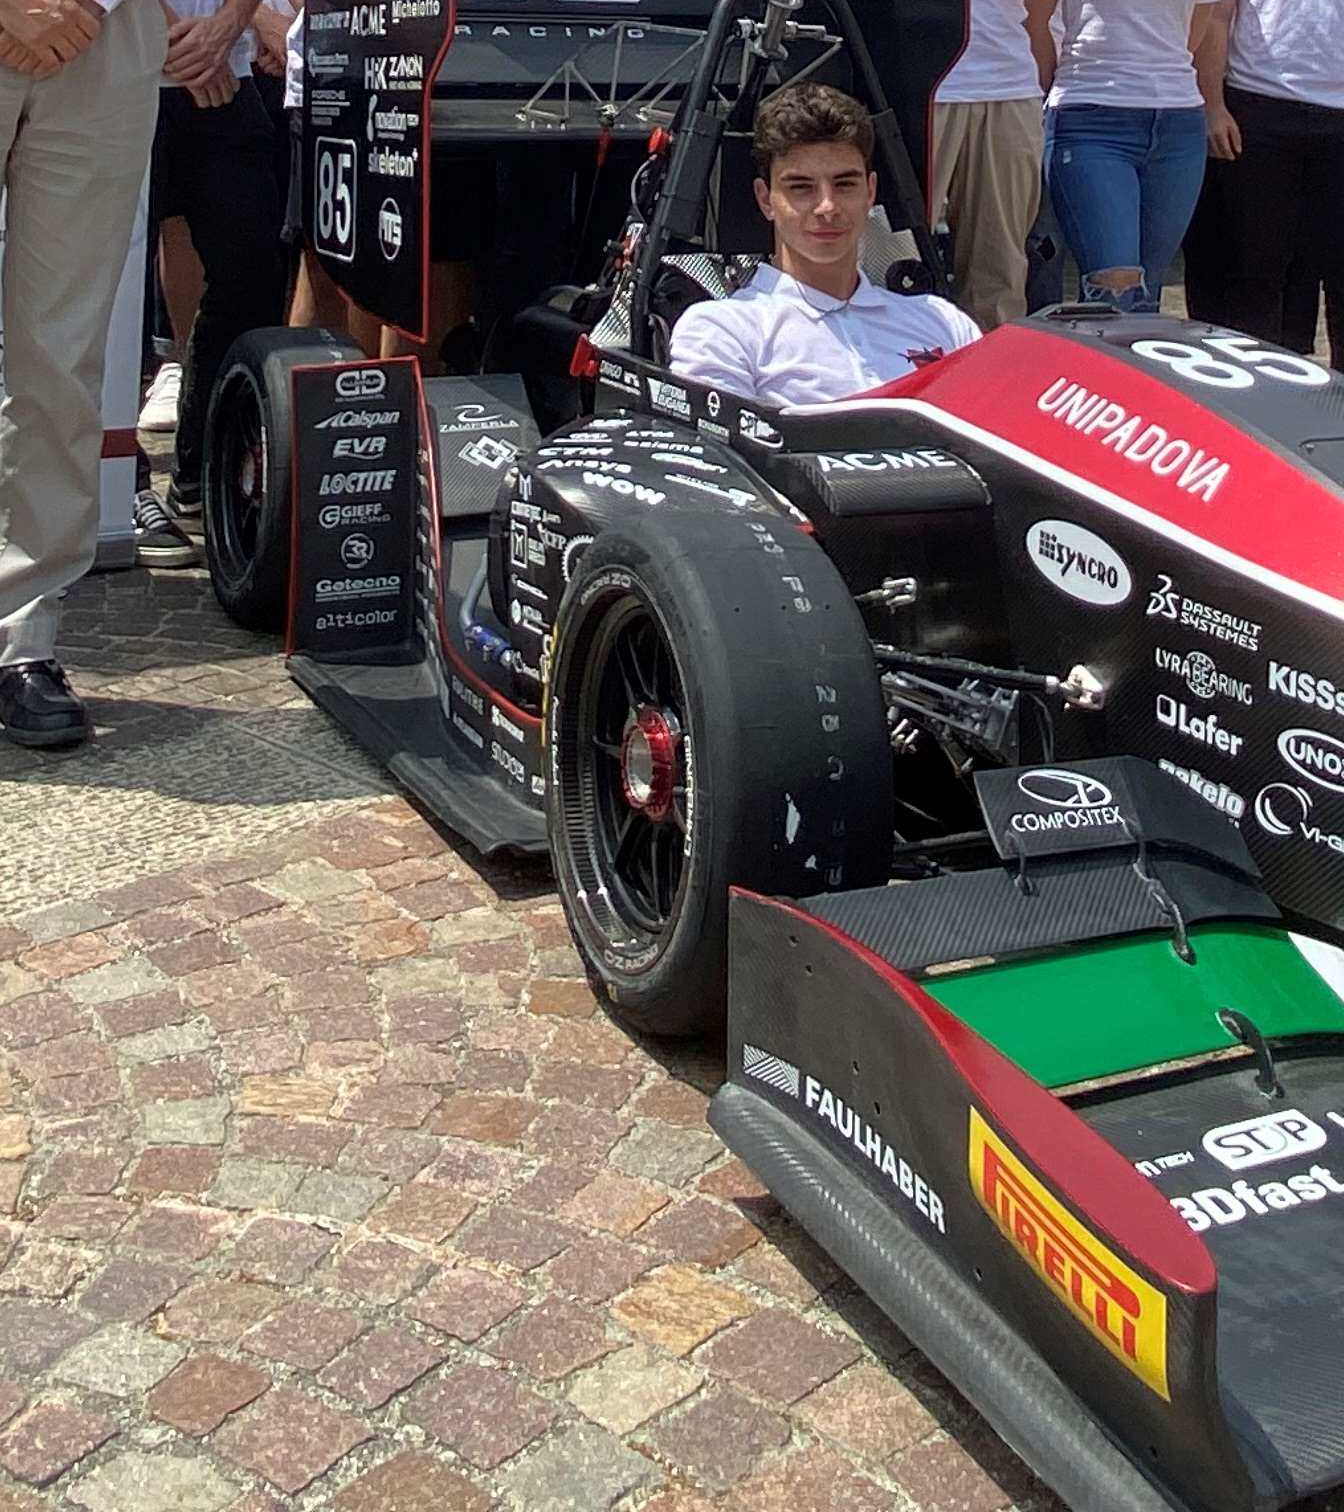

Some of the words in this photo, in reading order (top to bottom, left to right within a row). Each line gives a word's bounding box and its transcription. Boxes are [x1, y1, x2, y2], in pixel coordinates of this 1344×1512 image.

[350, 4, 387, 37] ACME
[318, 150, 353, 245] 85
[1130, 335, 1332, 389] 85
[816, 446, 958, 473] ACME
[1036, 376, 1231, 504] UNIPADOVA
[319, 469, 398, 496] LOCTITE
[1055, 541, 1119, 589] SYNCRO
[316, 608, 398, 630] alticolor
[1181, 597, 1262, 637] DASSAULT
[1011, 806, 1125, 833] COMPOSITEX
[803, 1074, 947, 1235] FAULHABER
[981, 1138, 1142, 1364] PIRELLI
